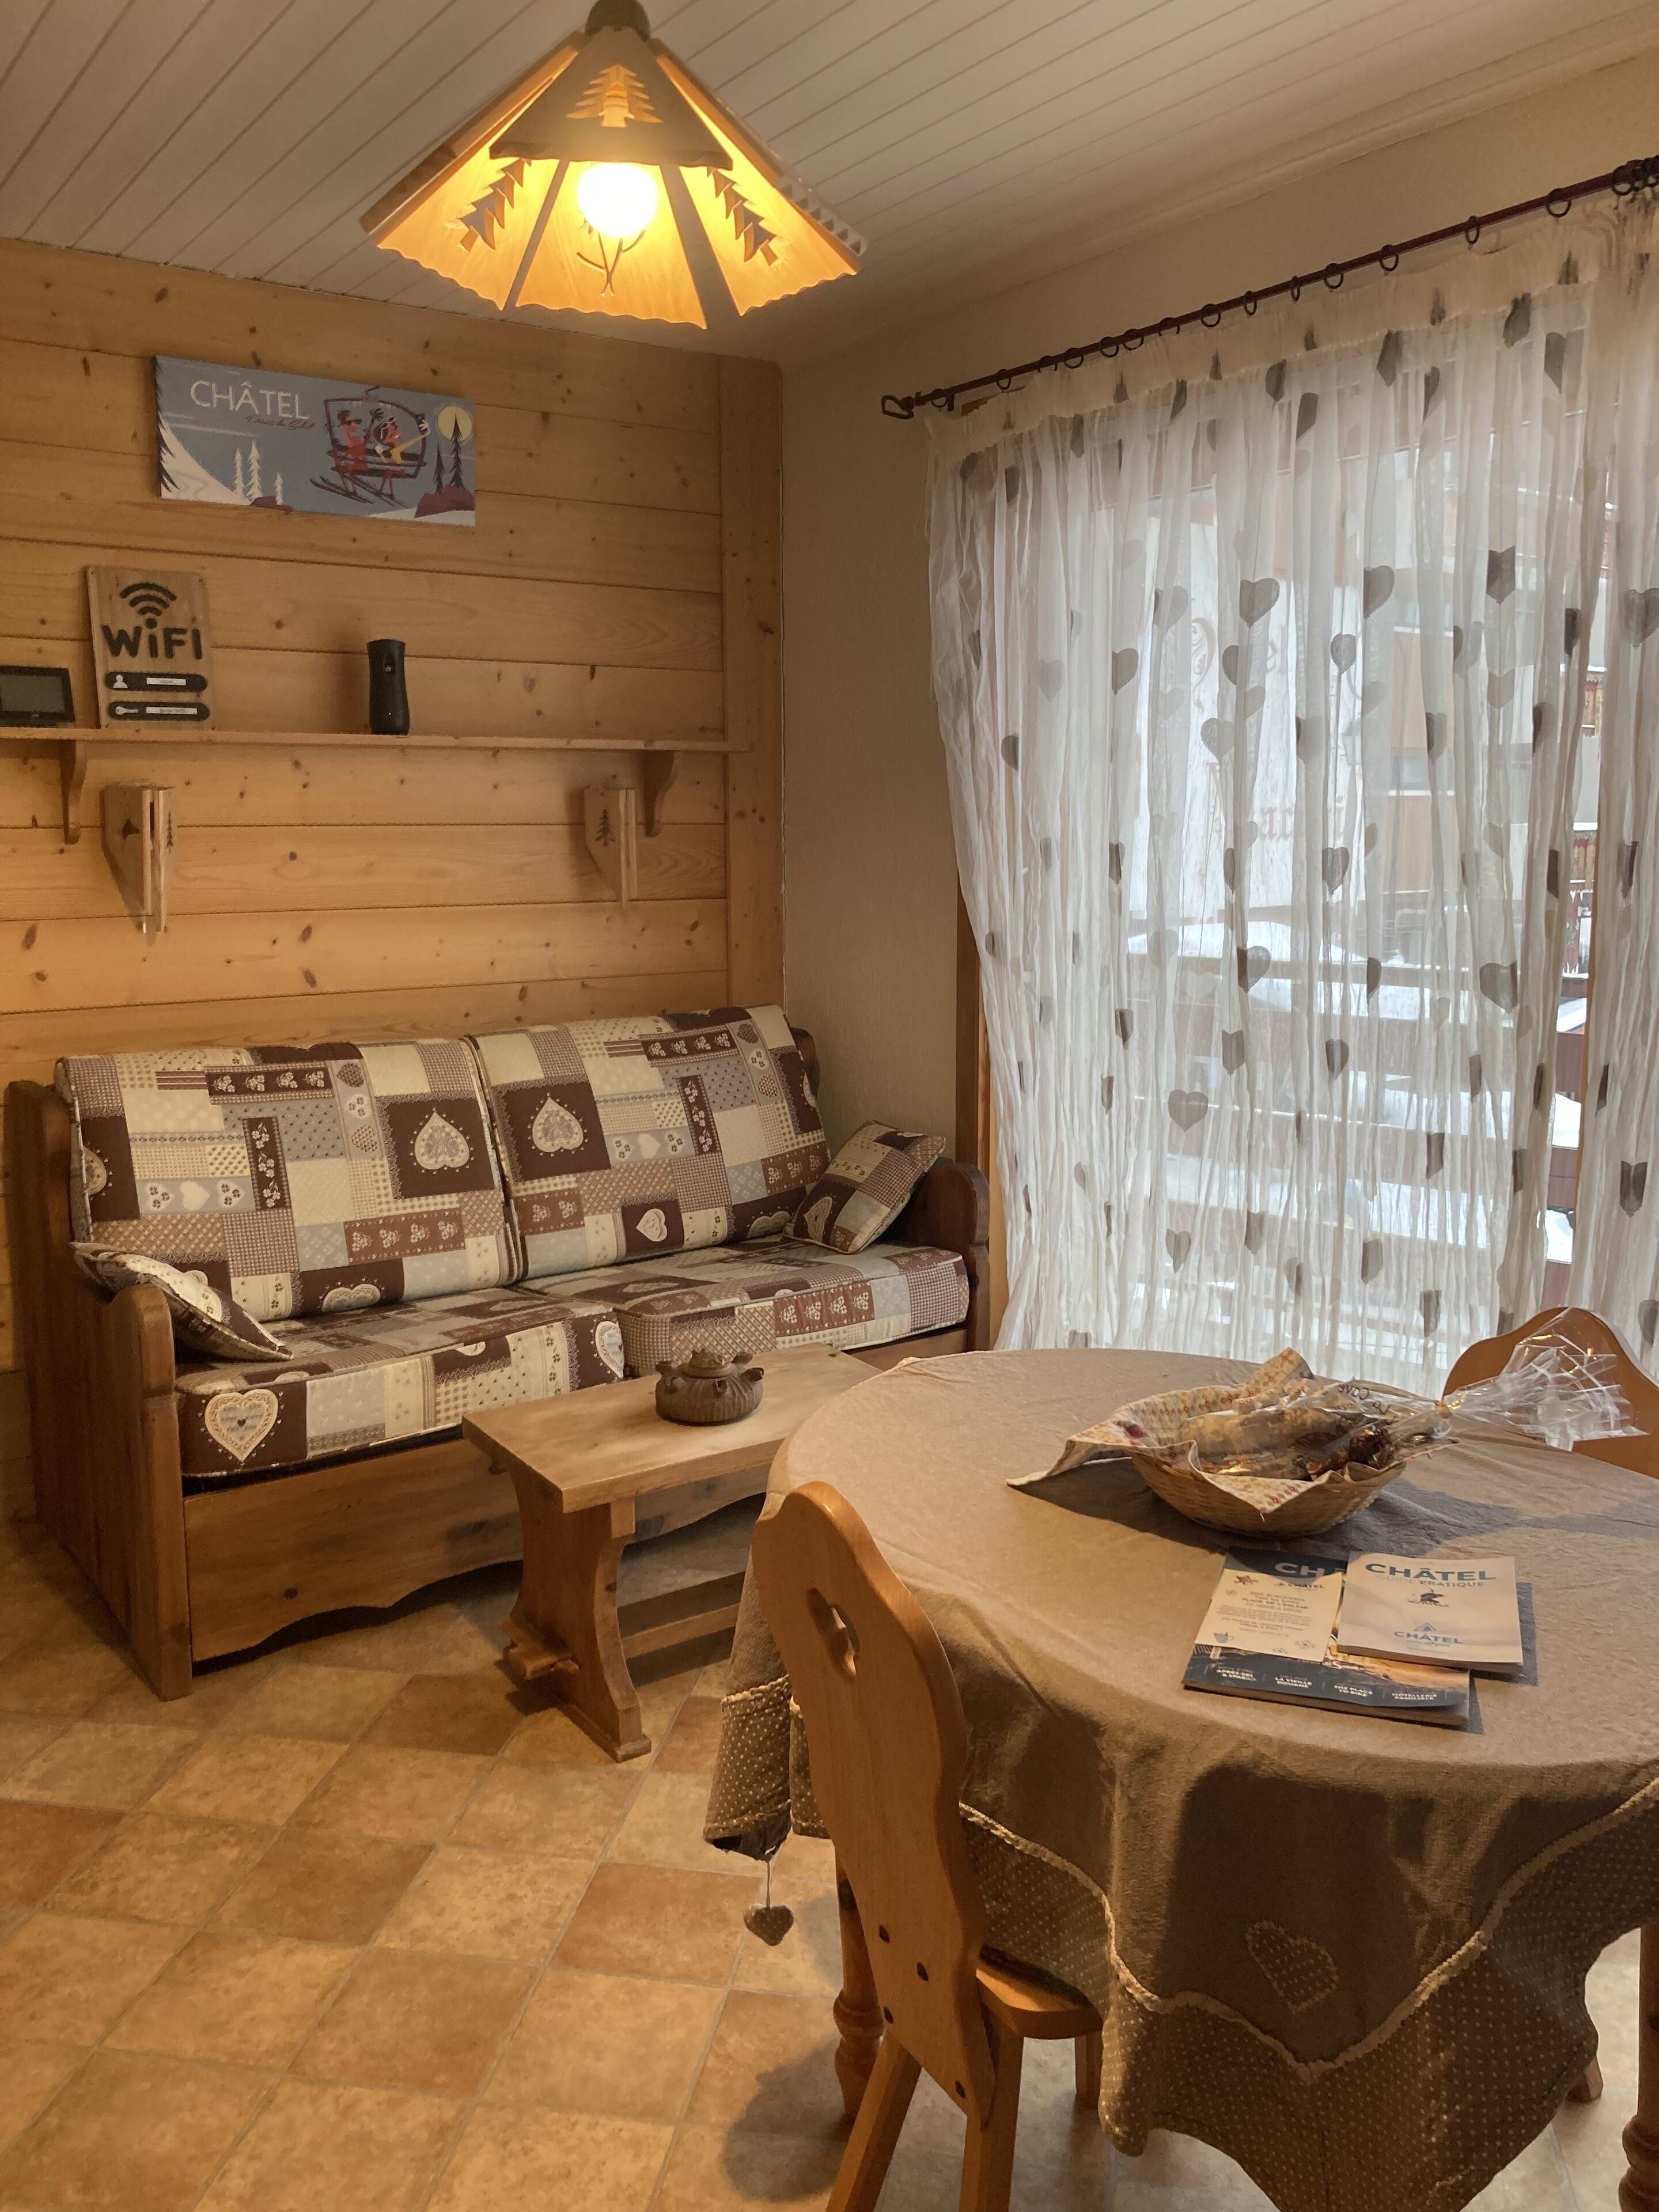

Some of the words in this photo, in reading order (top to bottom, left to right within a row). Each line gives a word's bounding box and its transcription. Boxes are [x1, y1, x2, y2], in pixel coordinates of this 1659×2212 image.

[190, 380, 310, 420] CHÂTEL
[1365, 1563, 1497, 1581] CHÂTEL
[1419, 1580, 1485, 1588] PRATIQUE
[1393, 1631, 1464, 1644] CHÂTEL
[1349, 1687, 1373, 1695] PLACE
